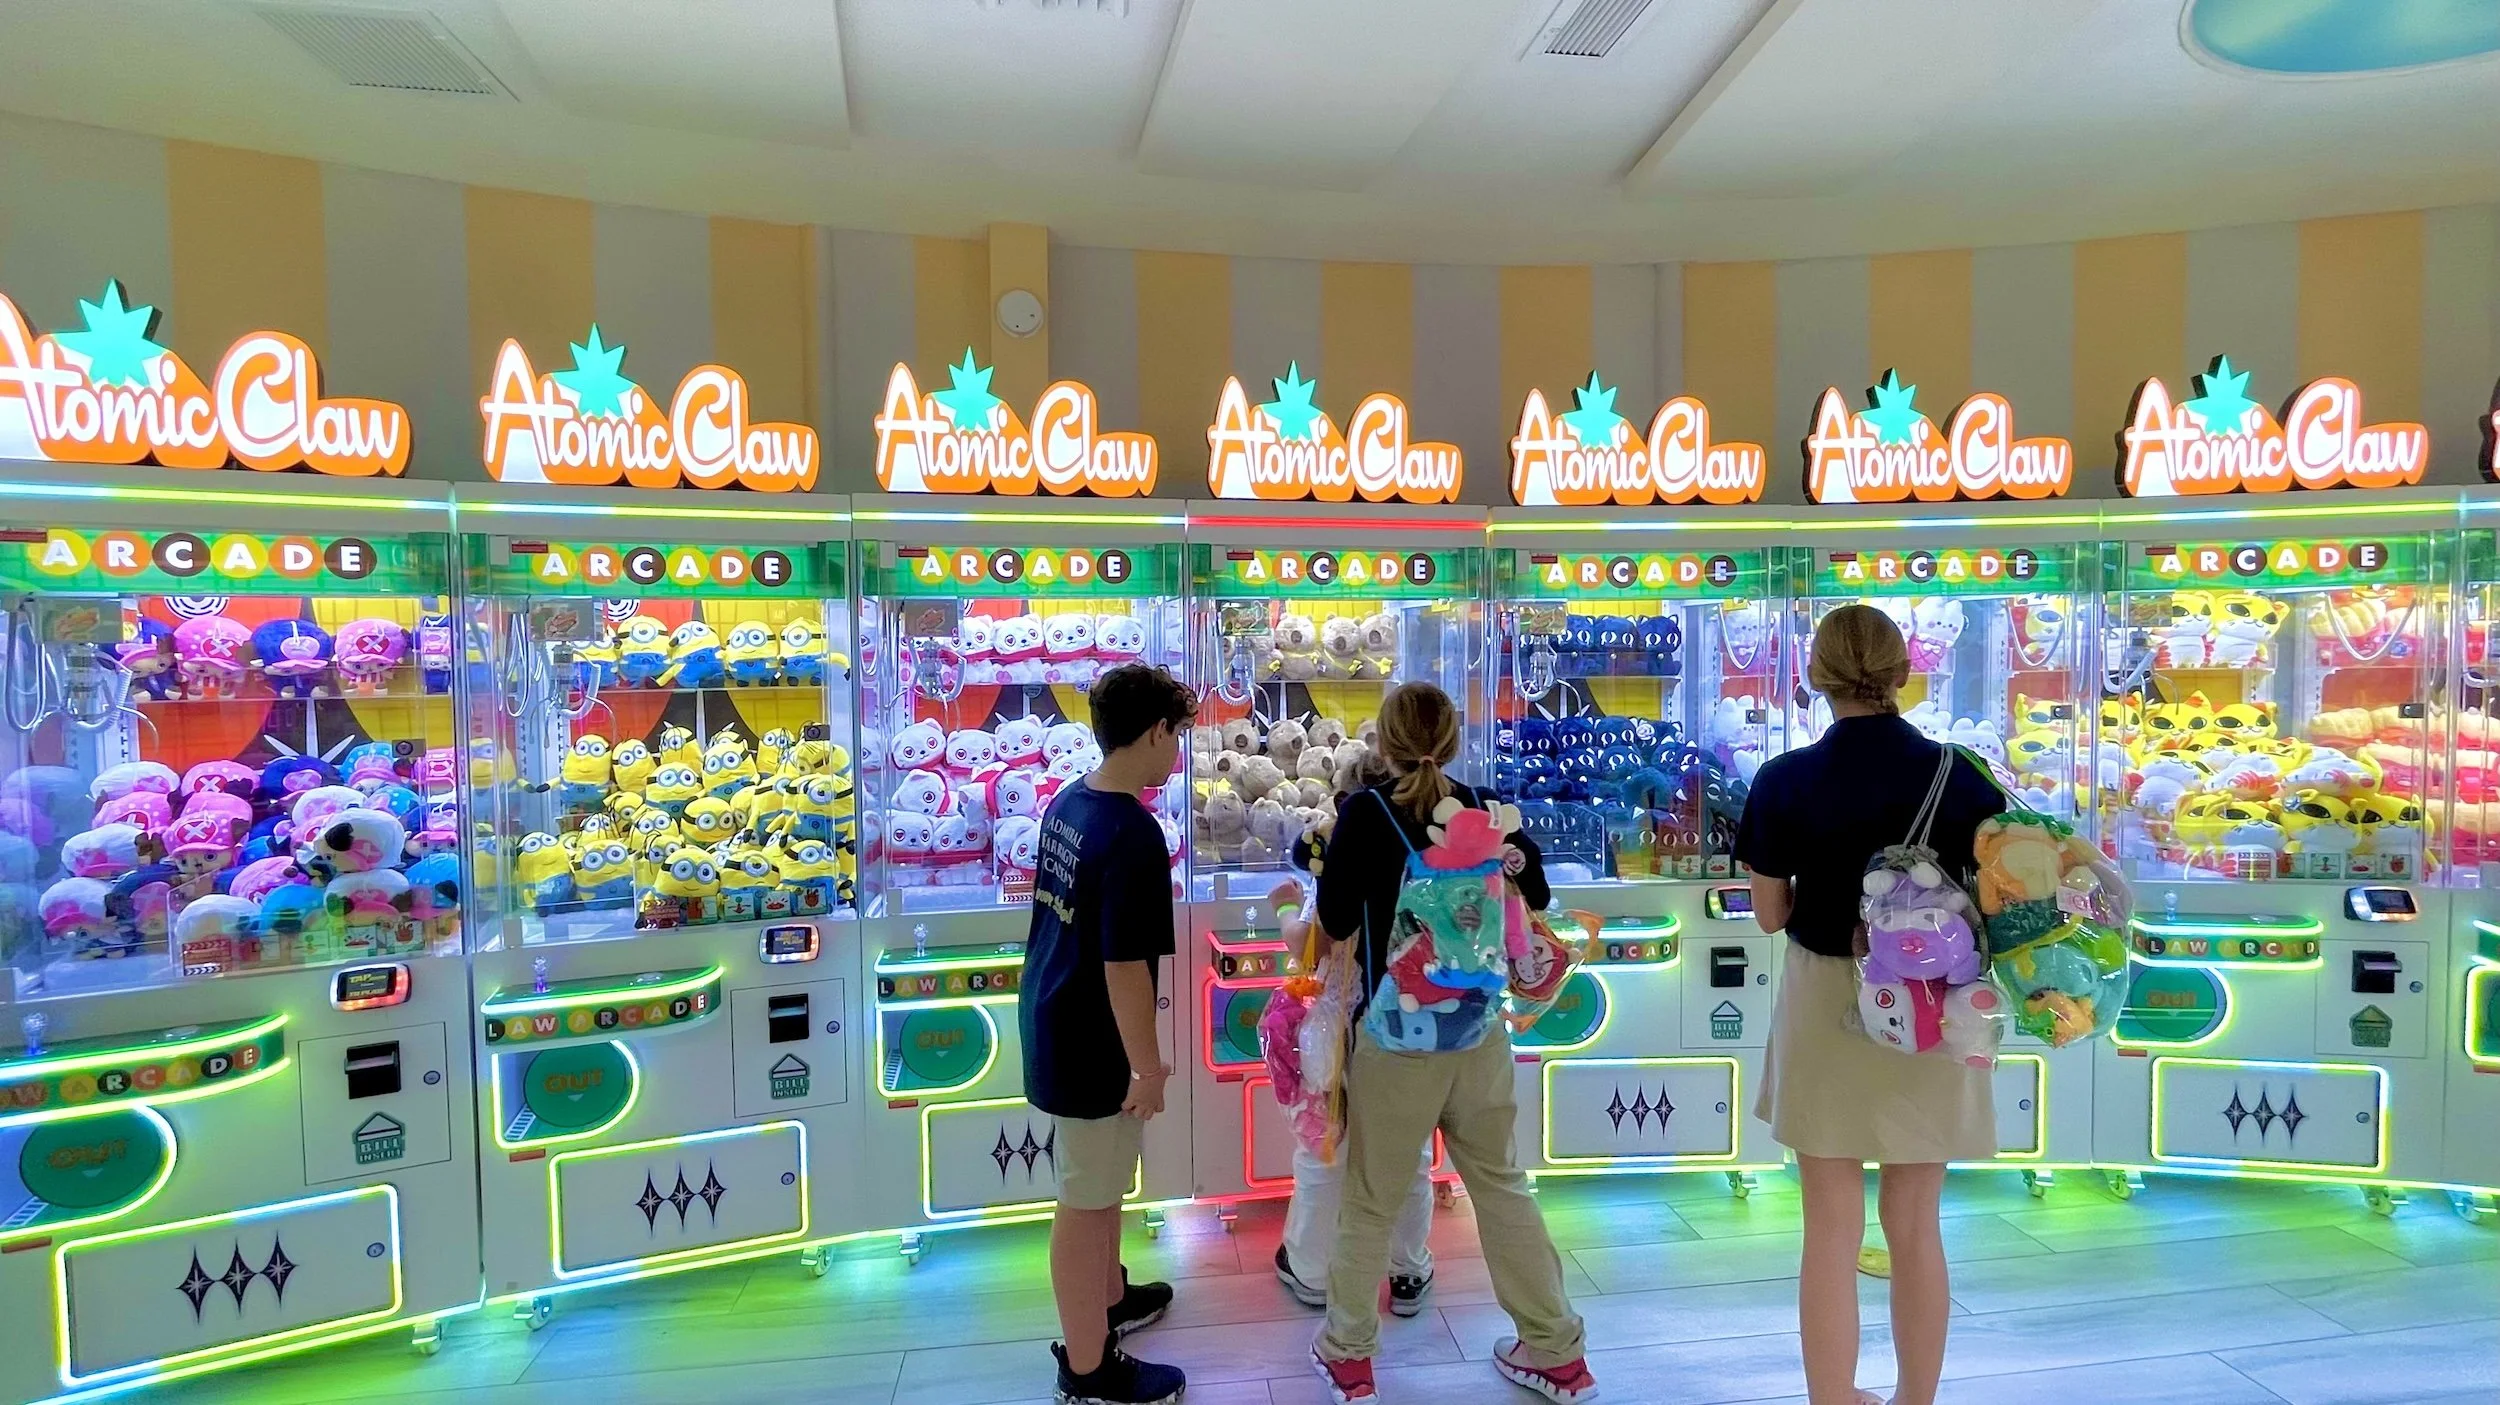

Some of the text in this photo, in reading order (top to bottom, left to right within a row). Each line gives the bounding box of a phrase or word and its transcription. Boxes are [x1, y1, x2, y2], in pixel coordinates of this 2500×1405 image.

[217, 336, 400, 459] Claw
[483, 344, 813, 477] Atomic Claw
[874, 368, 1153, 482] Atomic Claw
[1210, 382, 1458, 493] Atomic Claw
[2124, 382, 2423, 490] Atomic Claw
[1513, 395, 1761, 495] Atomic Claw
[1809, 395, 2066, 490] Atomic Claw
[42, 538, 362, 573] ARCADE
[542, 552, 780, 581] ARCADE
[920, 553, 1123, 579] ARCADE
[1245, 556, 1427, 580] ARCADE
[1546, 559, 1729, 584] ARCADE
[1843, 554, 2031, 579] ARCADE
[2160, 545, 2377, 573] ARCADE
[1609, 943, 1671, 959] RCAD
[573, 994, 705, 1026] ARCADE
[71, 1048, 254, 1096] ARCADE
[544, 1069, 604, 1094] OUT
[360, 1138, 400, 1153] BILL
